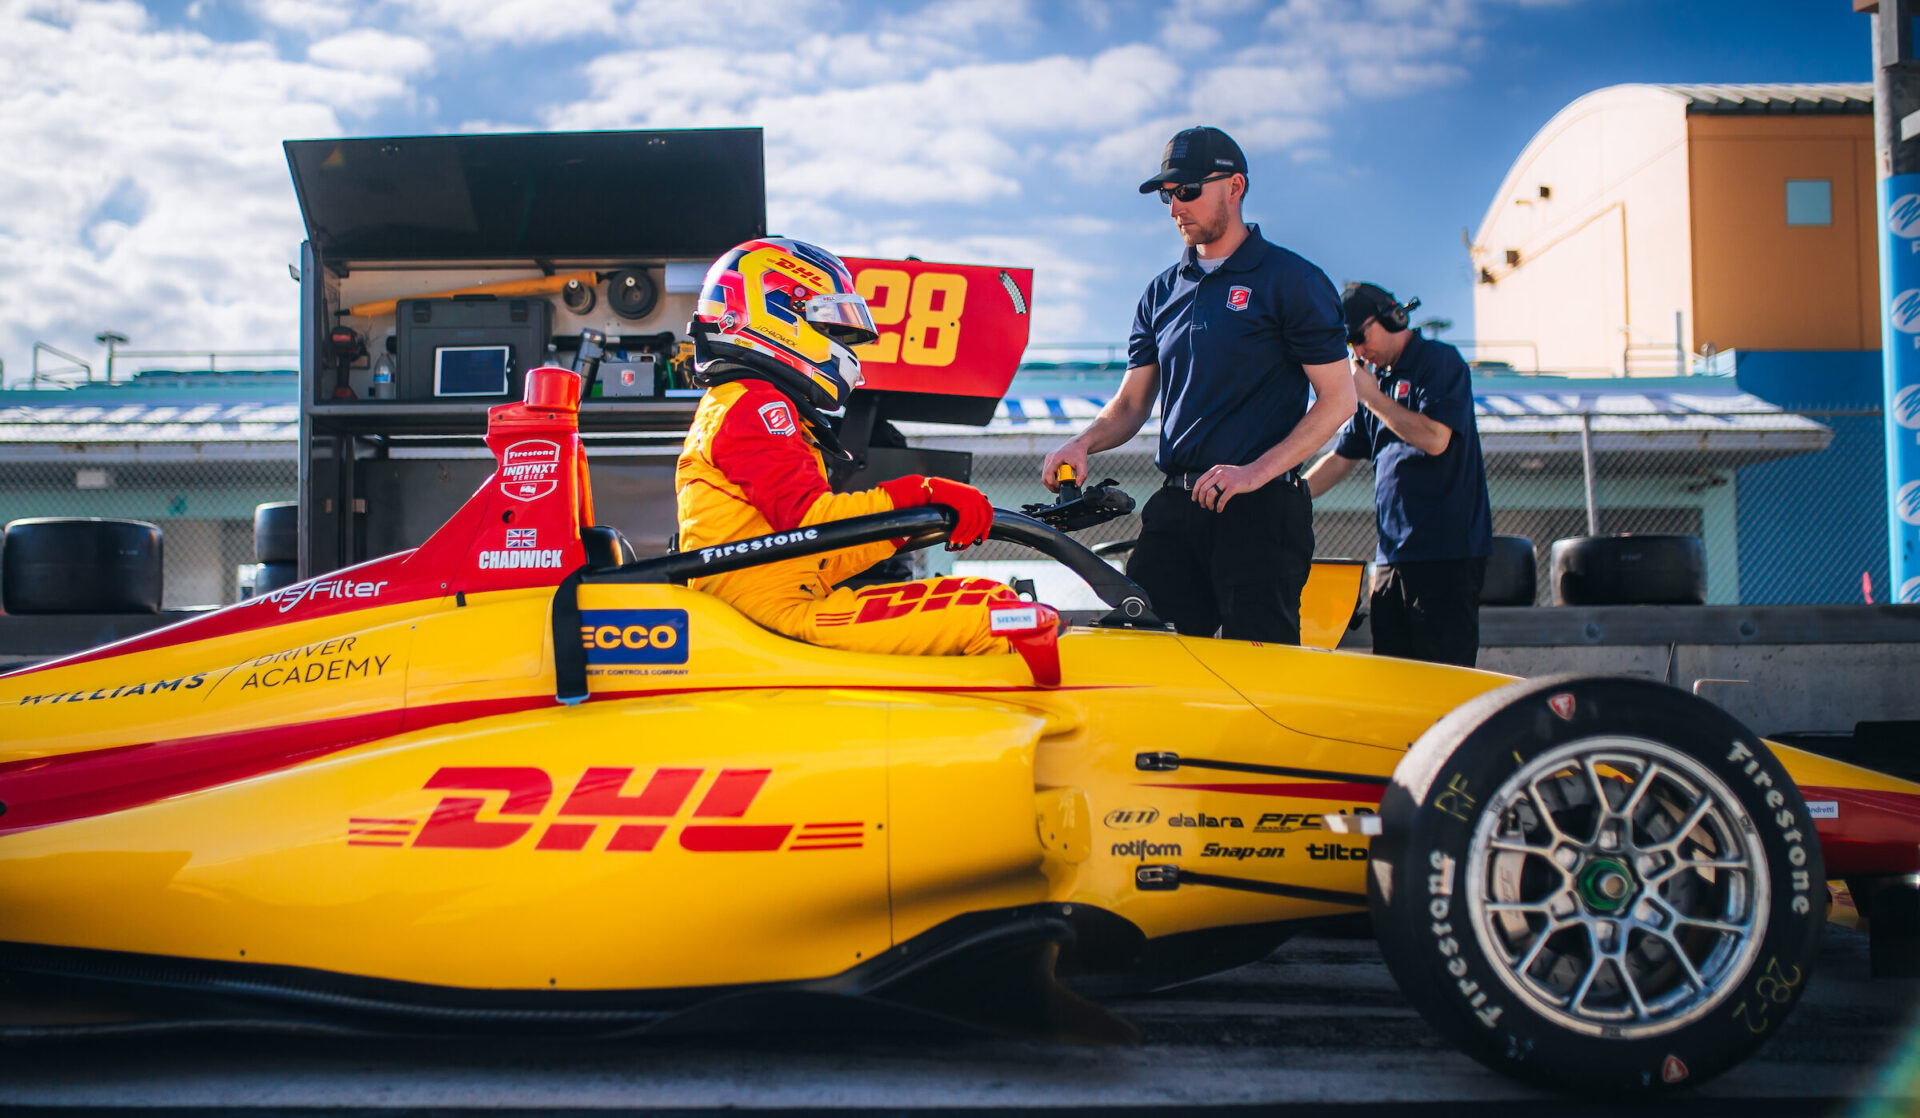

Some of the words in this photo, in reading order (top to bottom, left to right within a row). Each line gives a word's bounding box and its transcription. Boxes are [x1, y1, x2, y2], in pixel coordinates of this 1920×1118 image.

[775, 258, 823, 287] DHL
[851, 268, 968, 367] 28
[503, 464, 558, 476] INDYNXT
[509, 450, 554, 459] Firestone
[479, 550, 563, 569] CHADWICK
[700, 527, 818, 564] Firestone
[254, 637, 356, 667] DRIVER
[241, 655, 391, 690] ACADEMY
[20, 673, 206, 705] WILLIAMS
[411, 767, 794, 852] DHL
[1168, 813, 1244, 828] dallara
[1257, 814, 1321, 826] PFC
[1727, 741, 1810, 915] Firestone
[1111, 839, 1182, 862] rotiform
[1200, 843, 1285, 860] Snap-on
[1428, 850, 1503, 1028] Firestone
